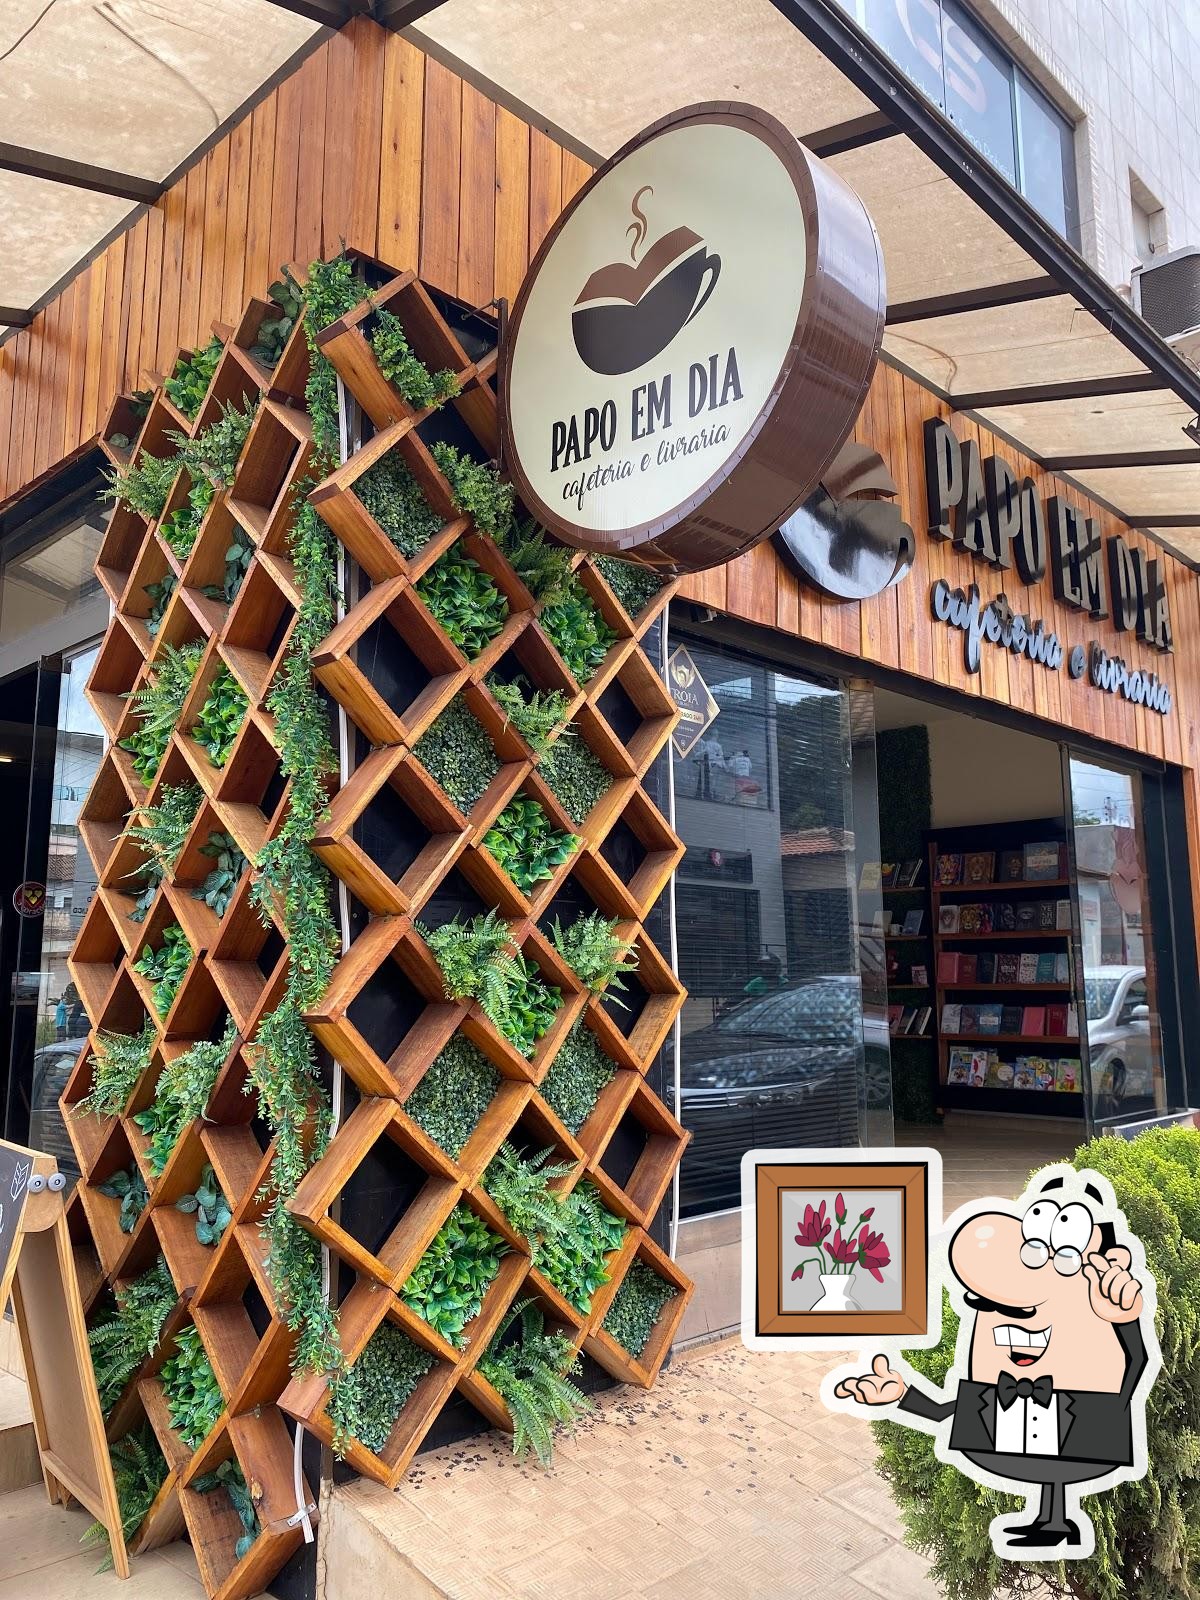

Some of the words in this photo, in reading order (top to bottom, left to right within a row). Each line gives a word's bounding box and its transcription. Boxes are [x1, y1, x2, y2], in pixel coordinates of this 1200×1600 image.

[550, 399, 618, 473] PAPO
[631, 374, 673, 442] EM
[688, 347, 744, 419] DIA
[562, 456, 635, 511] cafeteria
[640, 452, 651, 472] e
[656, 423, 732, 467] livraria
[923, 417, 1046, 586] PAPO
[1047, 495, 1109, 620] EM
[1107, 535, 1174, 654] DIA
[930, 578, 1064, 675] cafeteria
[1068, 644, 1088, 679] e
[1088, 640, 1173, 715] livraria
